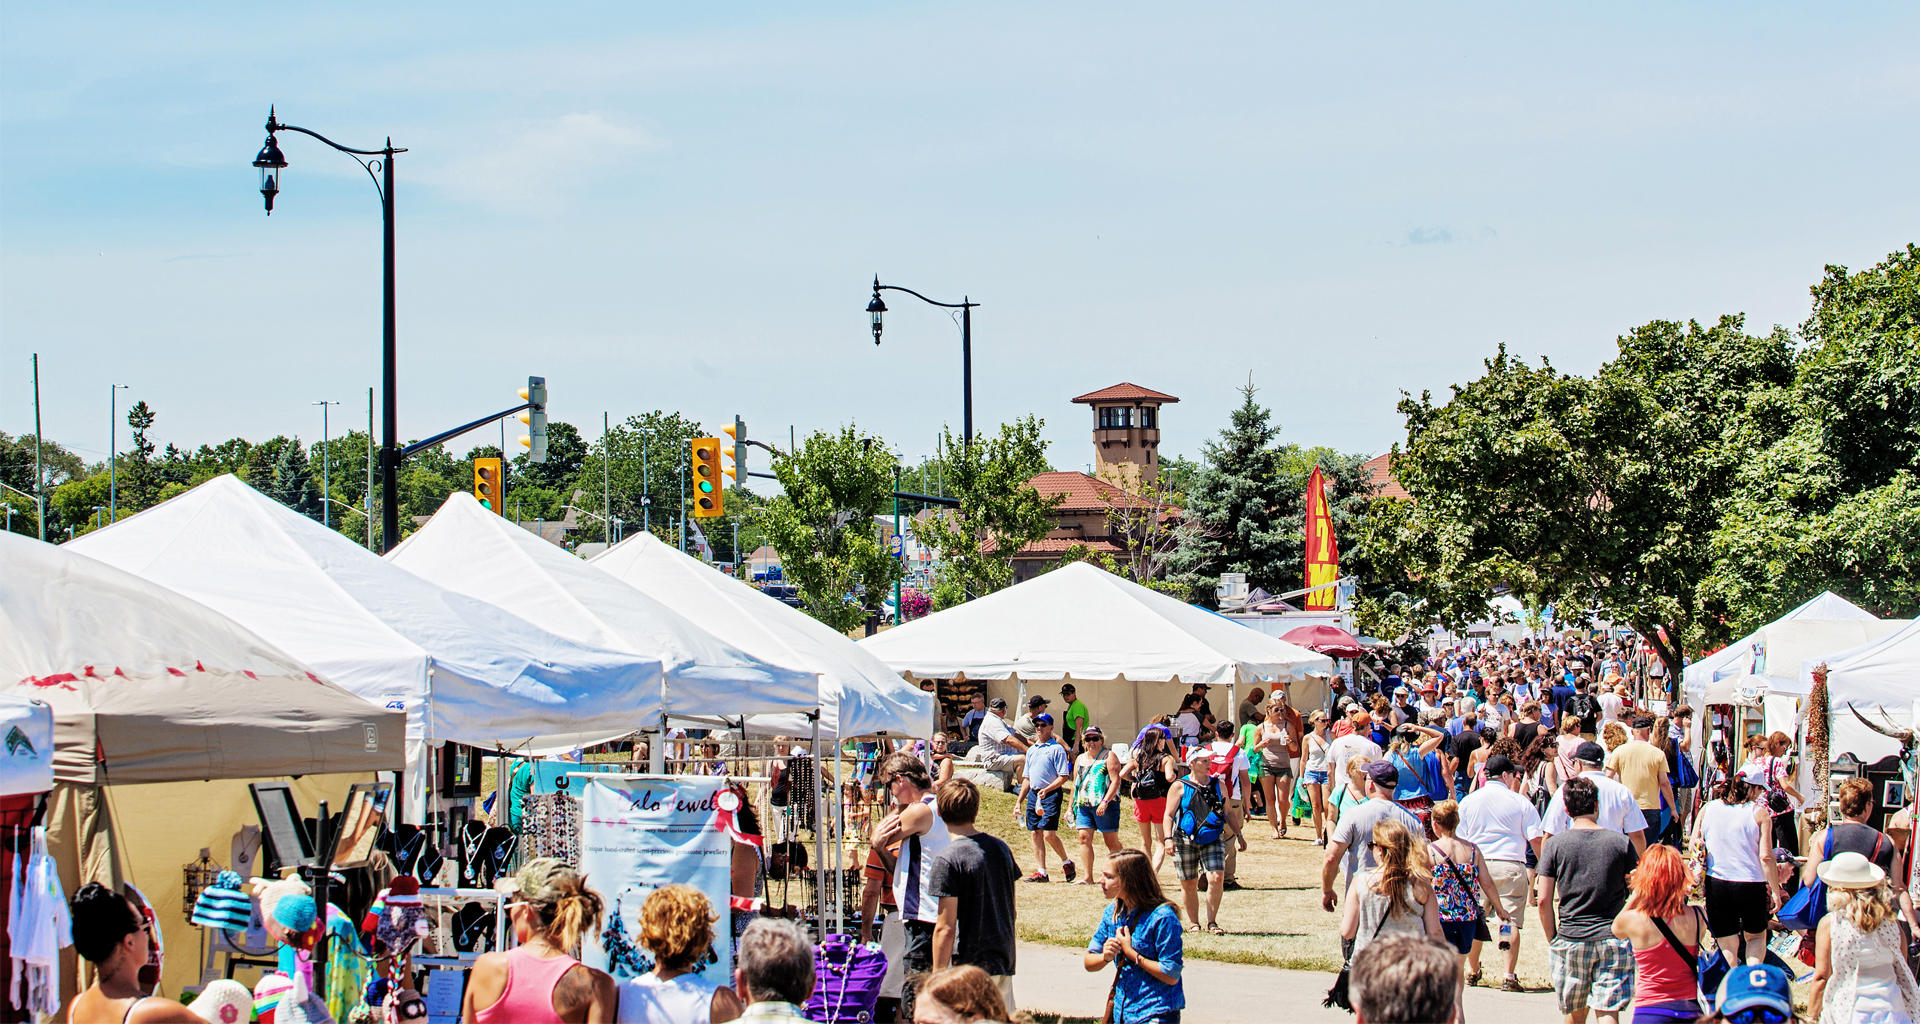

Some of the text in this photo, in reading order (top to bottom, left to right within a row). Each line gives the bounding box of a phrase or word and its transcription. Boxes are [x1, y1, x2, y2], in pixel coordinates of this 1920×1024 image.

[666, 789, 718, 813] Jewel
[584, 844, 603, 853] Unique
[604, 845, 636, 853] hand-crafted
[703, 847, 728, 856] jewellery
[1749, 969, 1767, 987] C
